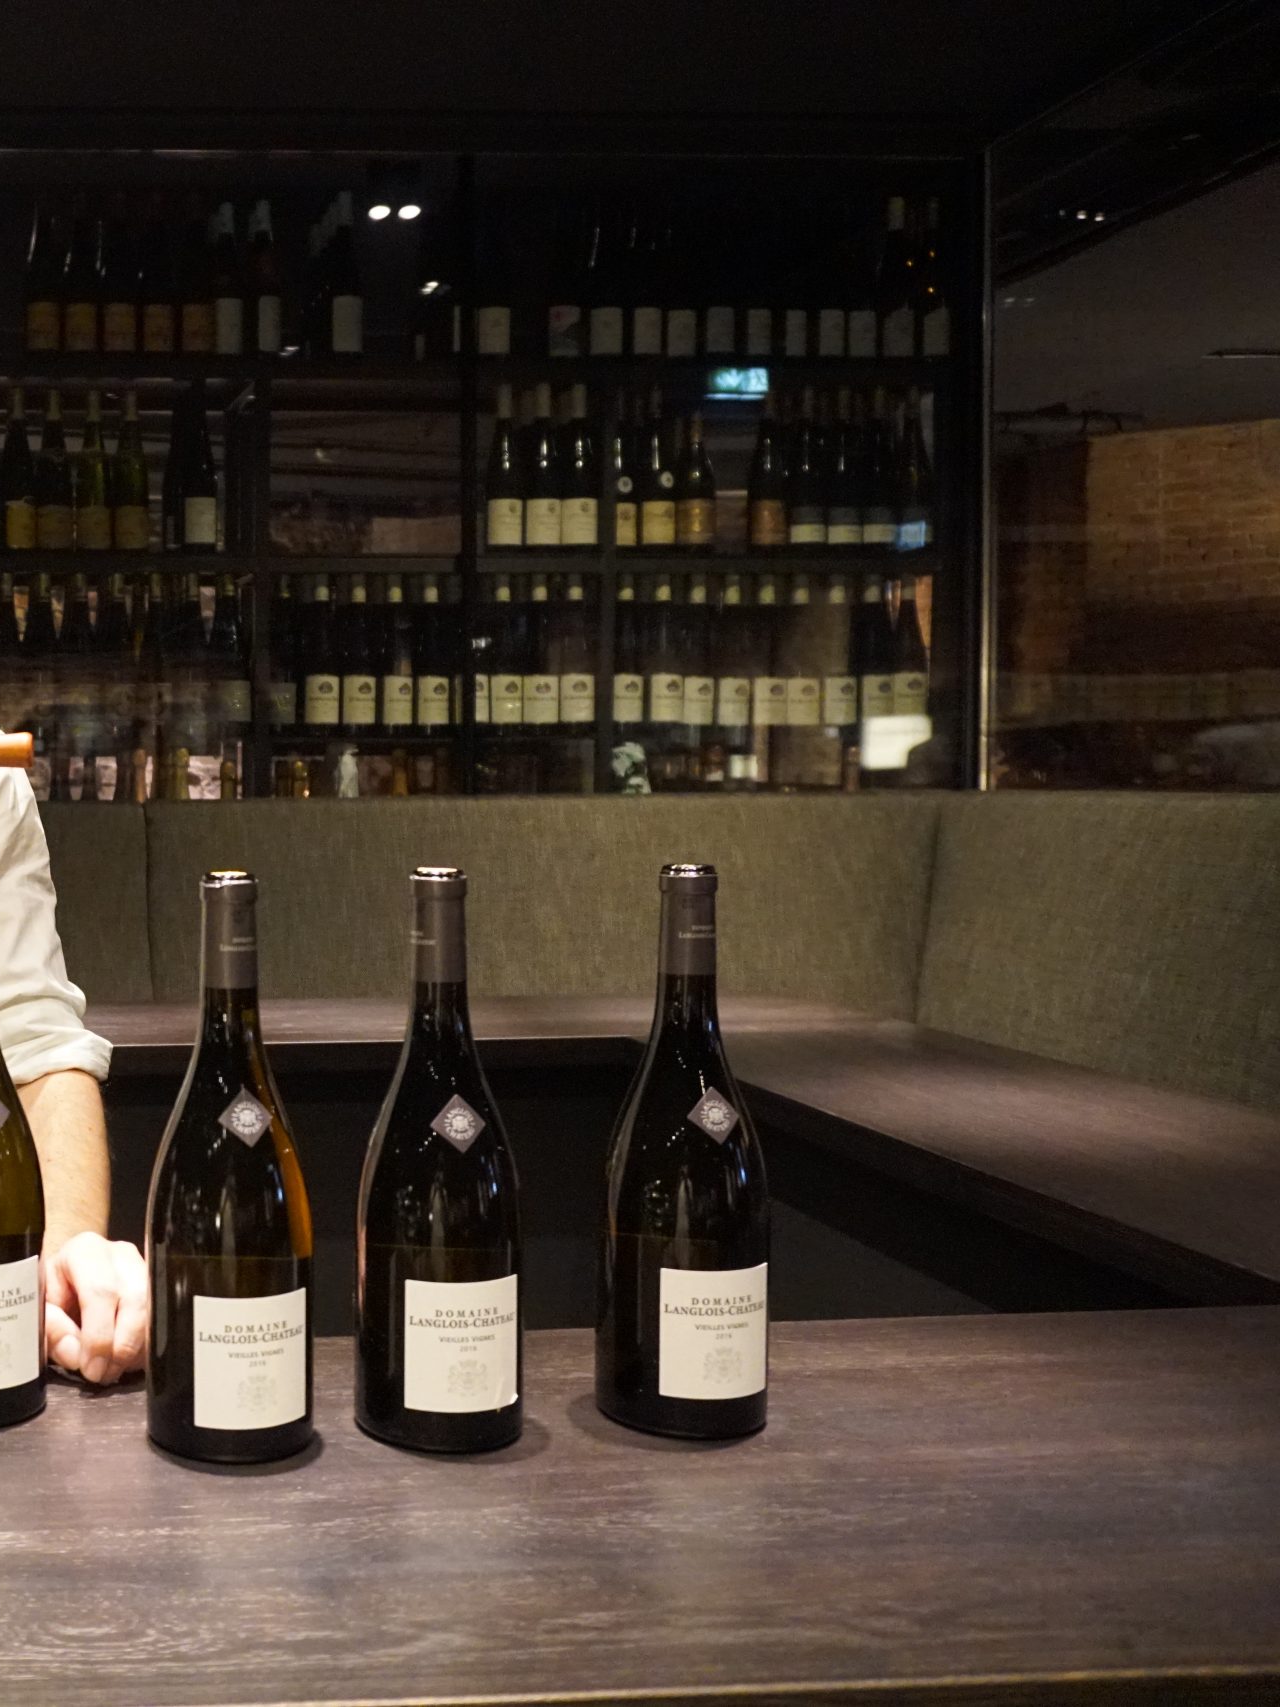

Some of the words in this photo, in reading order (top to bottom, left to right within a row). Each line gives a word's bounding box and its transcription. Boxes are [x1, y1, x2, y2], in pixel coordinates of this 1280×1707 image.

[691, 1294, 753, 1306] DOMAINE
[435, 1306, 498, 1318] DOMAINE
[224, 1320, 288, 1333] DOMAINE
